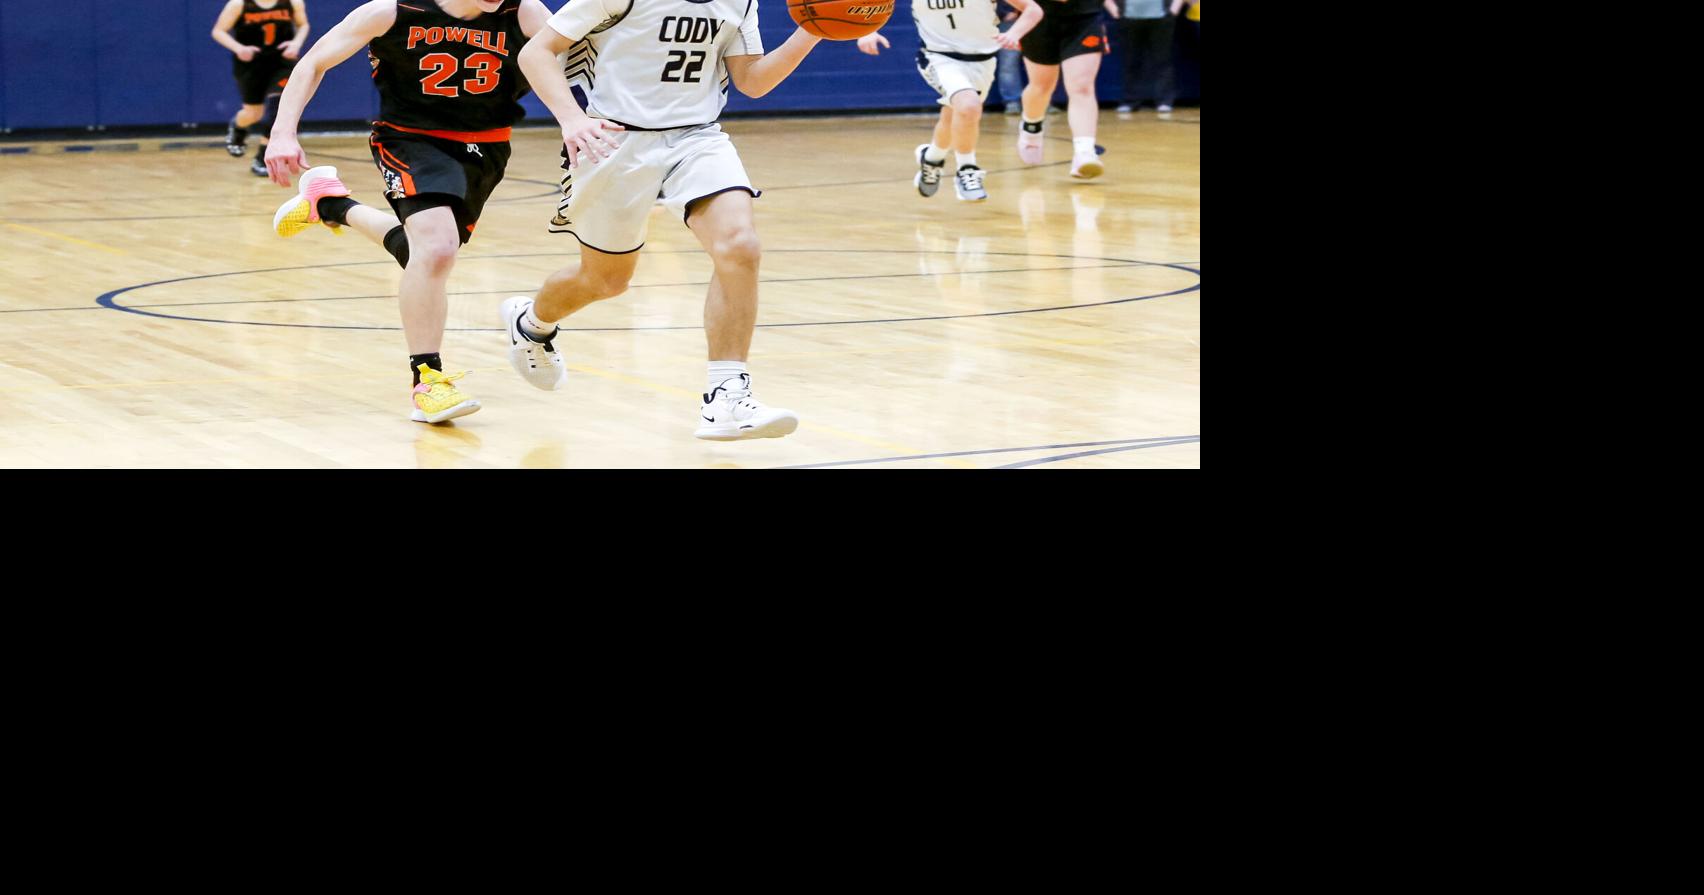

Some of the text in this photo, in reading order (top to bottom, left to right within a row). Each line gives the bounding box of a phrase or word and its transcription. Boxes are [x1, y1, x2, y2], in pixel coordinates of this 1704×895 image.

[262, 23, 275, 46] 1
[659, 16, 726, 44] CODY
[946, 13, 956, 30] 1
[407, 26, 509, 56] POWELL
[419, 53, 502, 97] 23
[661, 50, 706, 83] 22
